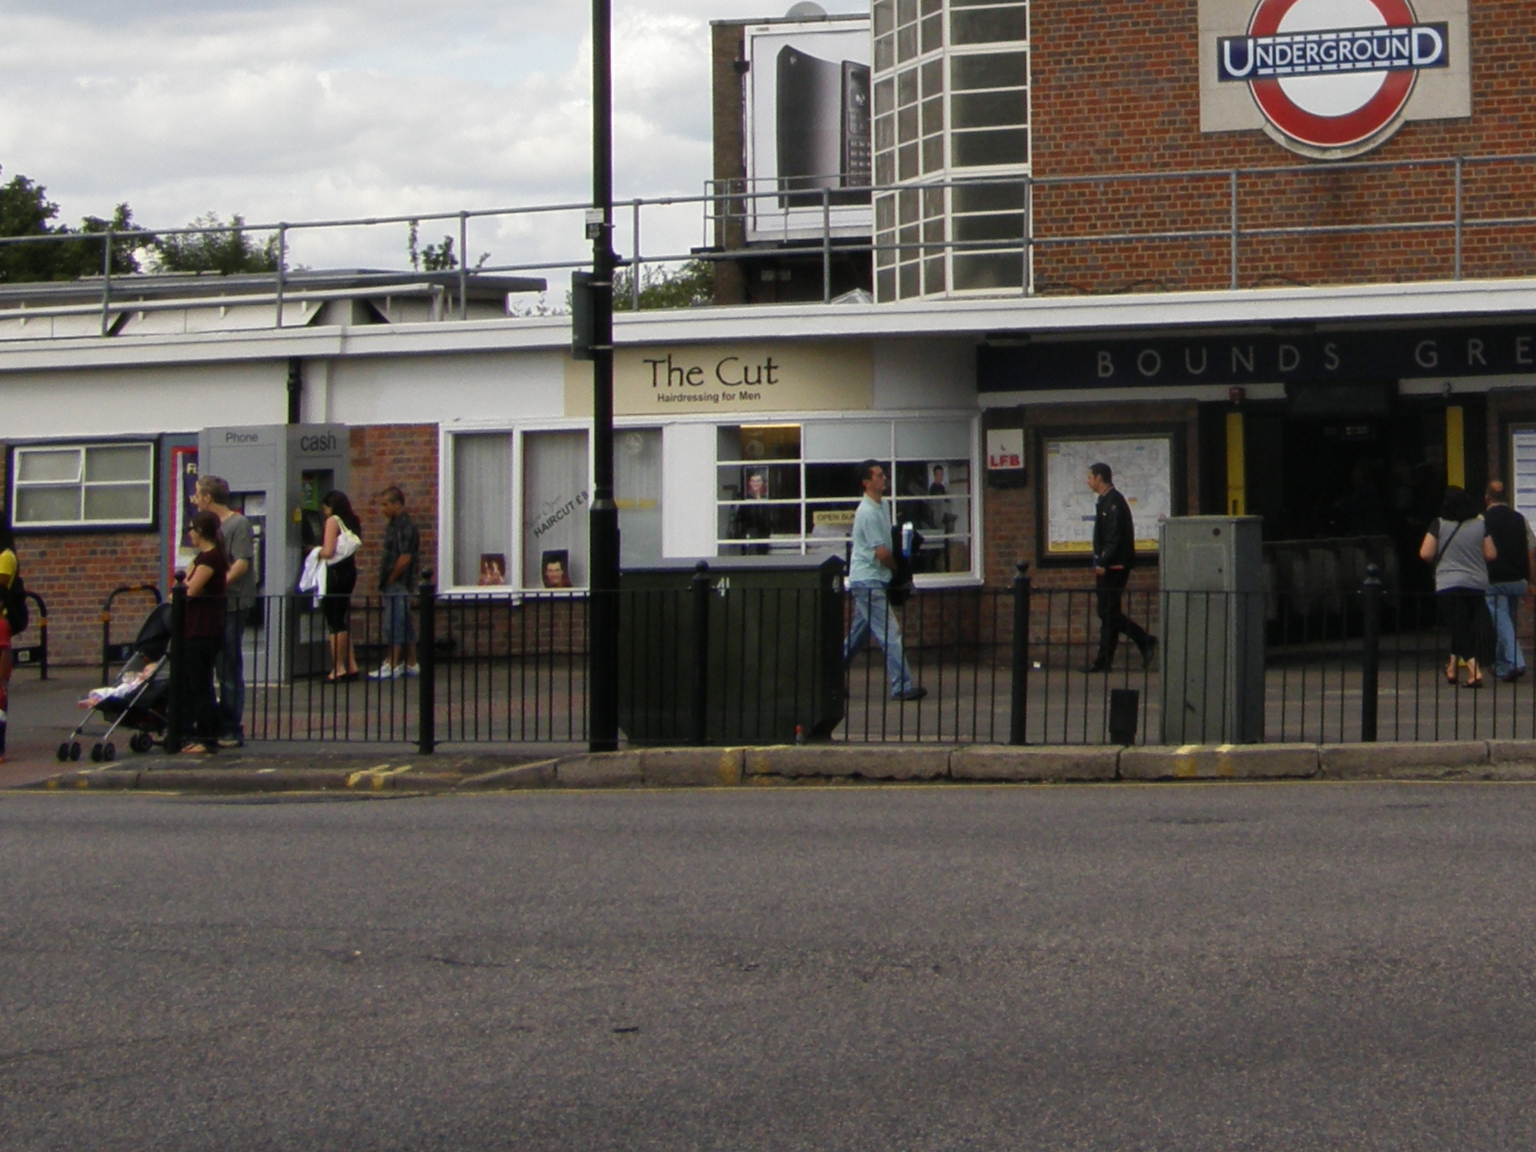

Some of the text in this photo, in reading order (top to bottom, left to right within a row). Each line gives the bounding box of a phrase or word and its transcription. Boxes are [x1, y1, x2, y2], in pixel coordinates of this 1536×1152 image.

[1222, 27, 1444, 77] UNDERGROUND
[642, 353, 779, 388] The Cut
[1097, 342, 1340, 378] BOUNDS
[657, 390, 761, 404] Hairdressing for Men
[225, 431, 337, 452] Phone cash
[990, 454, 1020, 467] LFB
[534, 499, 576, 538] HAIRCUT
